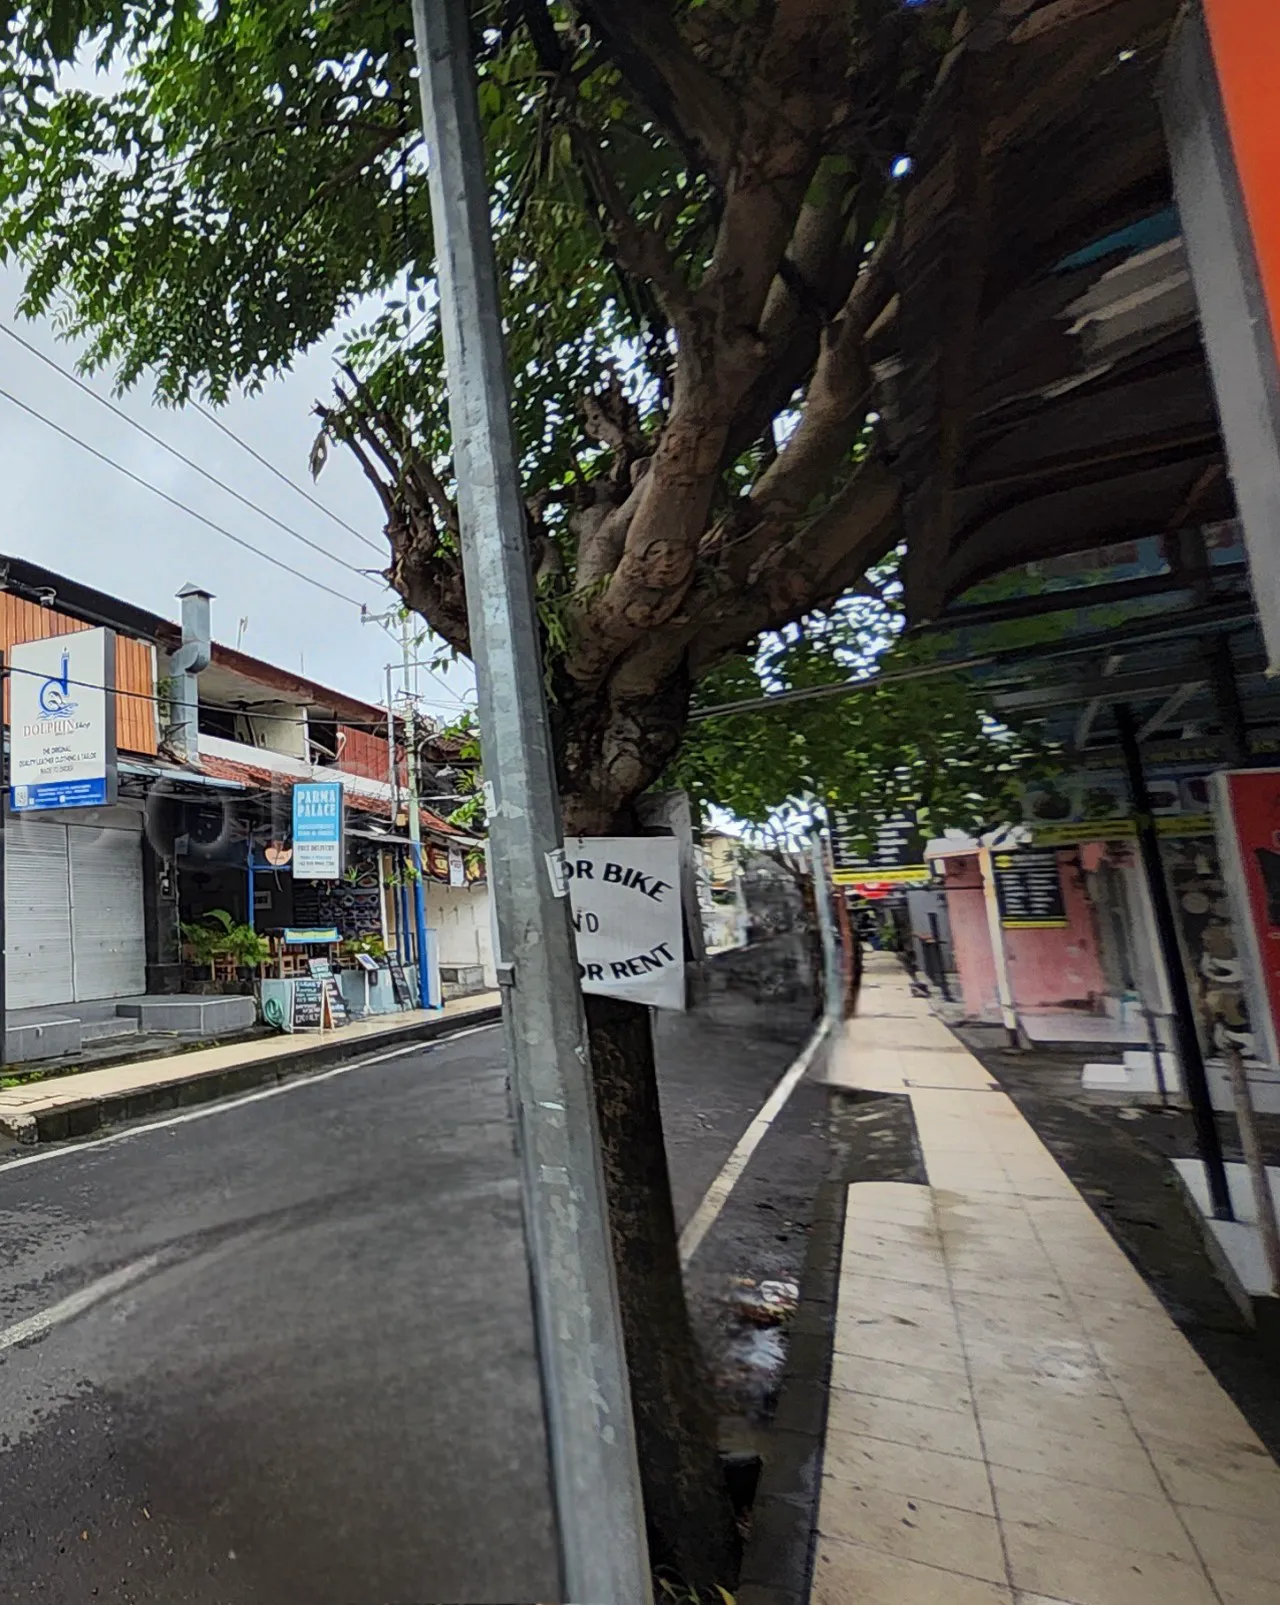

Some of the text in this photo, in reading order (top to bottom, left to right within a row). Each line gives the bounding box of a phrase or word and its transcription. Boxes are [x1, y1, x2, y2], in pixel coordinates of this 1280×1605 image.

[23, 720, 75, 737] DOLPHIN
[297, 789, 336, 804] PARMA
[297, 803, 336, 818] PALACE
[602, 862, 674, 903] BIKE
[609, 942, 676, 980] RENT
